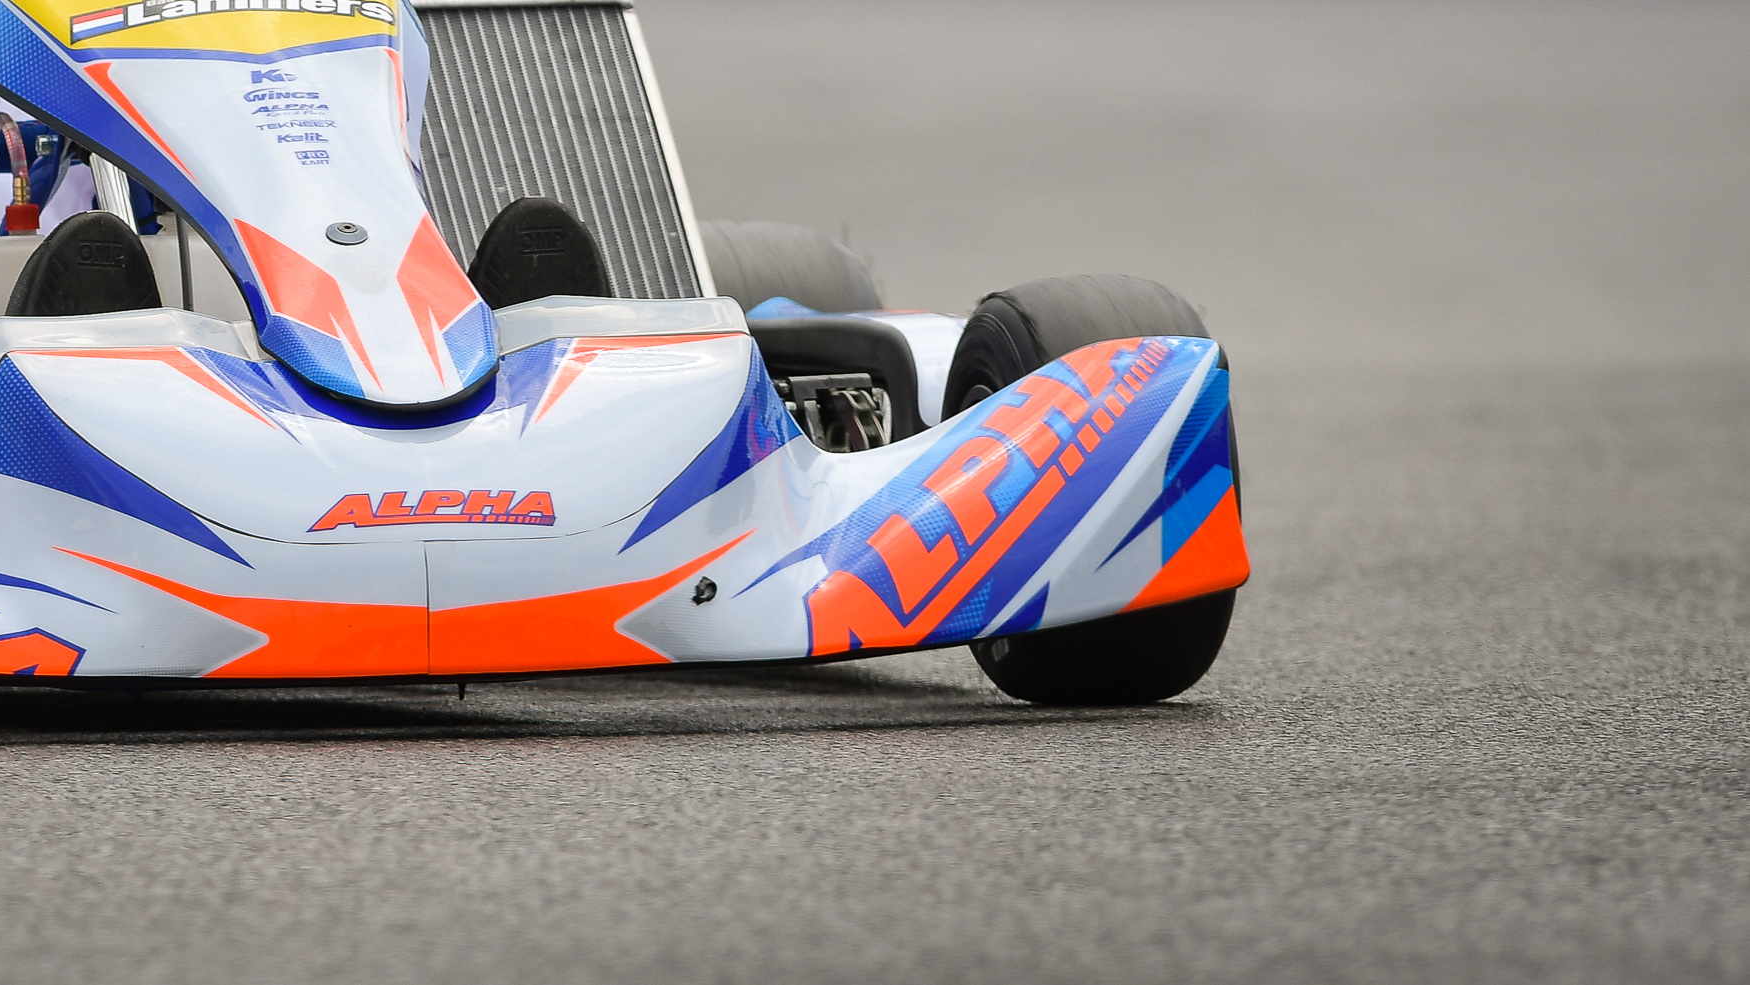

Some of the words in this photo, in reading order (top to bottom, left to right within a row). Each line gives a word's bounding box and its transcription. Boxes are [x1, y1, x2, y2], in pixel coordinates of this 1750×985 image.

[251, 104, 329, 115] ALPHA
[297, 151, 328, 159] PRO
[305, 489, 557, 532] ALPHA
[807, 337, 1146, 657] ALPHA
